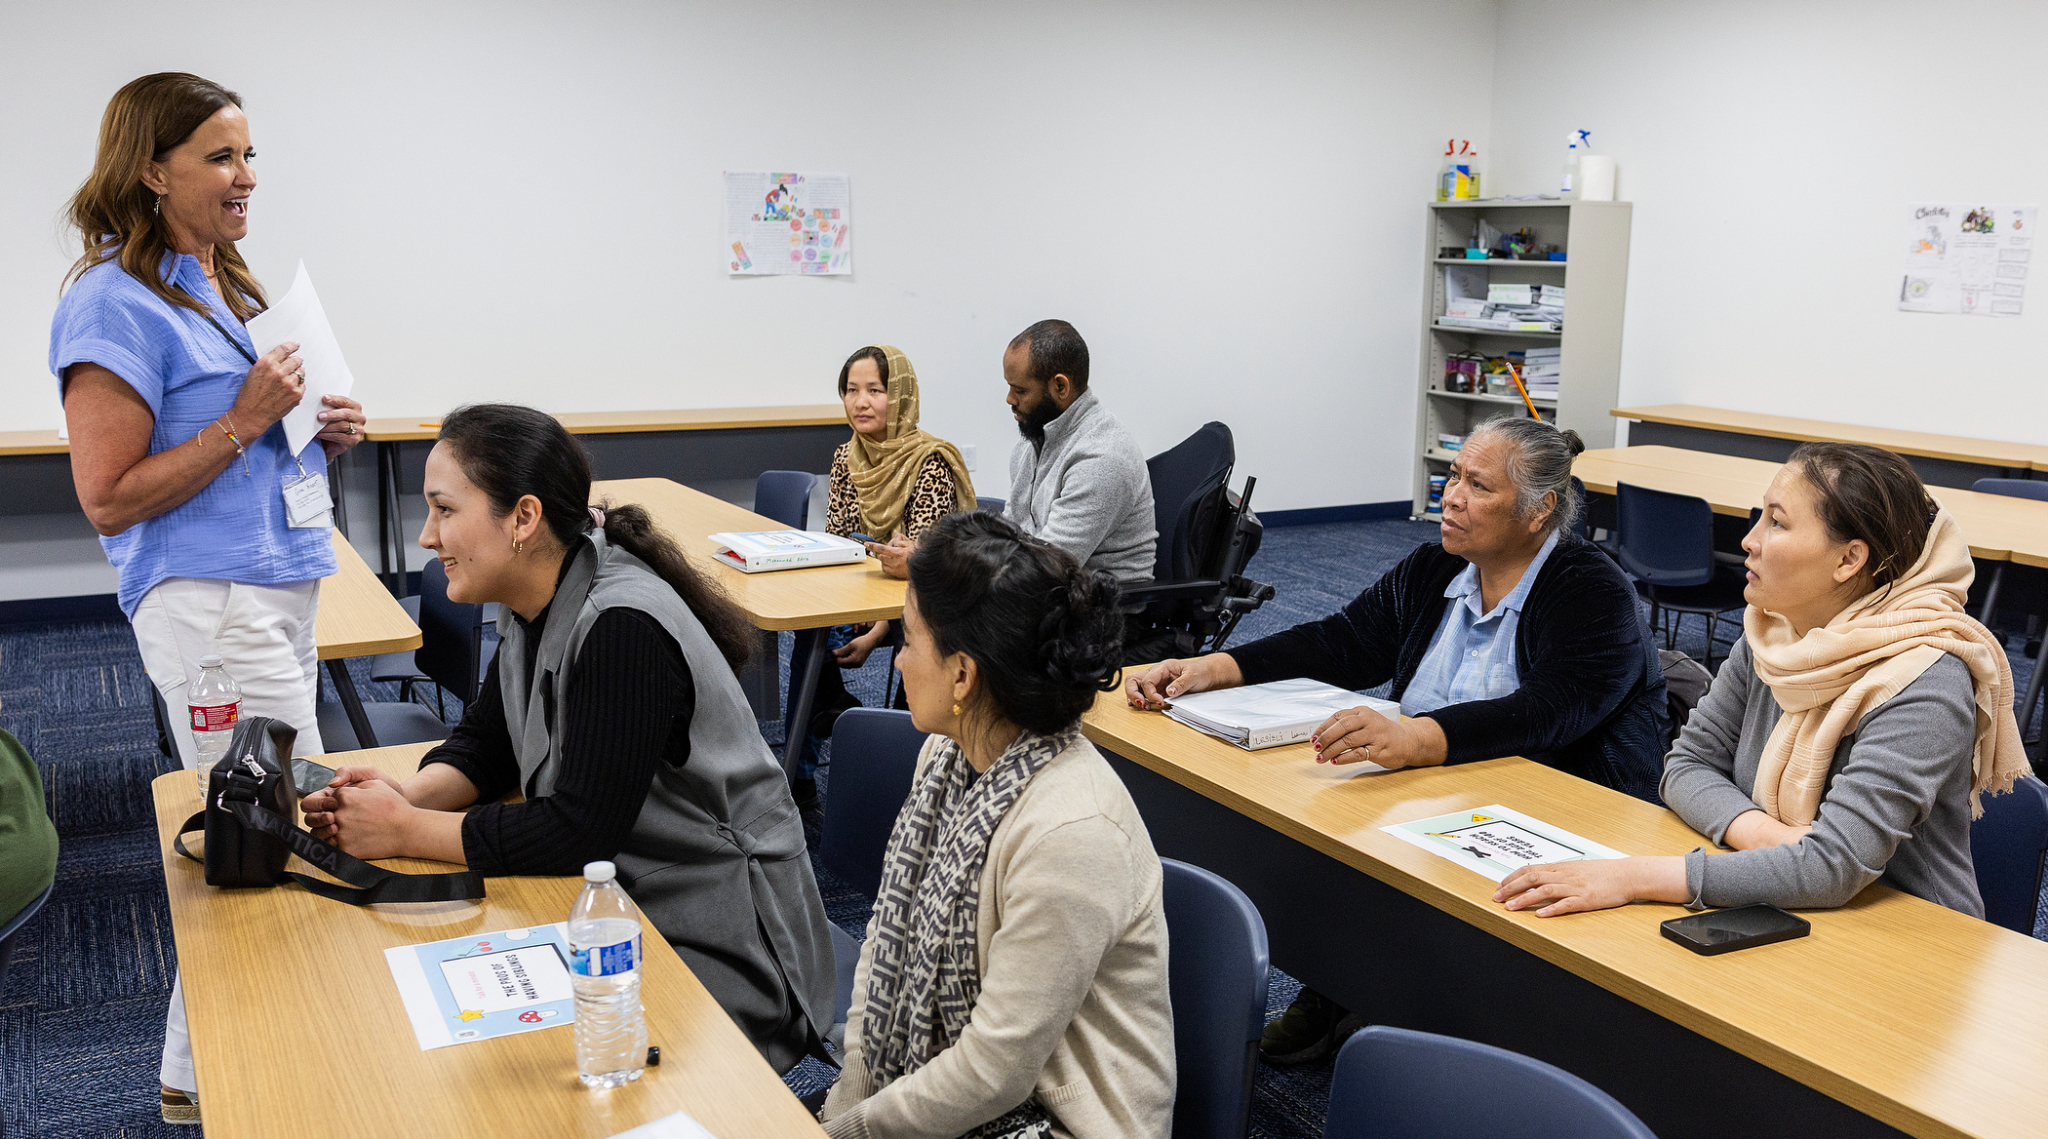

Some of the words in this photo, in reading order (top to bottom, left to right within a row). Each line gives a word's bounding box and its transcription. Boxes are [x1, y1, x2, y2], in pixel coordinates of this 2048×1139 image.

[250, 806, 338, 871] NAUTICA
[1506, 835, 1535, 849] YEARS
[1504, 842, 1525, 850] AGE
[1523, 850, 1543, 859] THE
[490, 963, 505, 971] OF
[504, 953, 528, 979] SIBLINGS
[494, 970, 513, 985] PROS
[501, 984, 518, 998] THE
[517, 978, 540, 1001] HAVING
